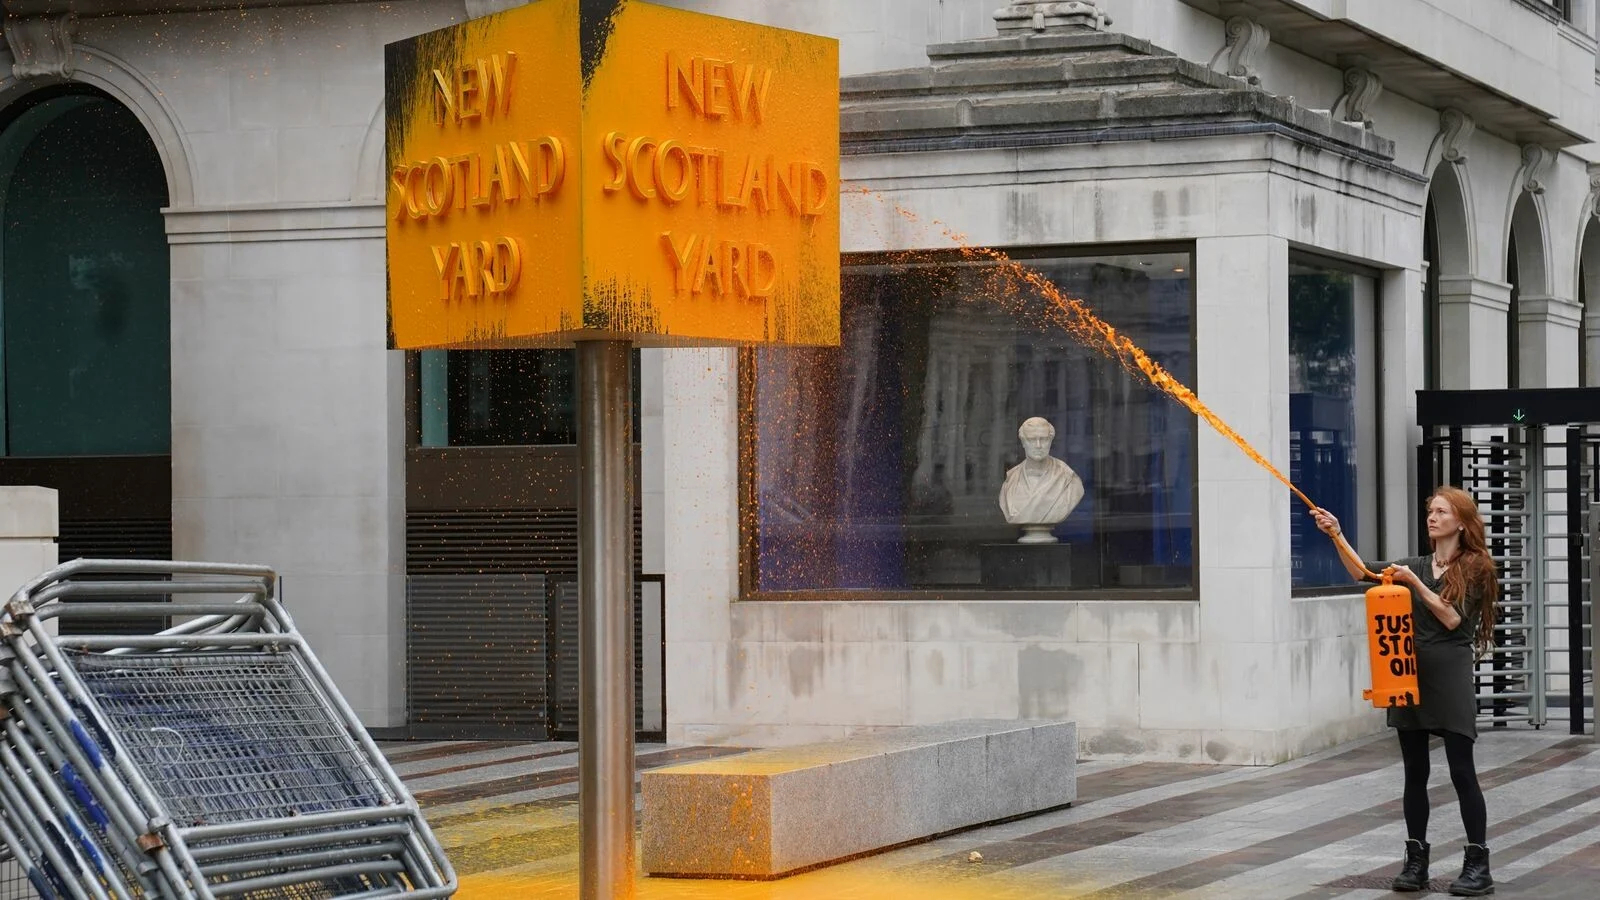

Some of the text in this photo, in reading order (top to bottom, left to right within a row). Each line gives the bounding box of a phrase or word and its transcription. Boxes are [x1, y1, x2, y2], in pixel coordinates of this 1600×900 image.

[433, 51, 517, 126] NEW
[666, 52, 772, 123] NEW
[392, 135, 565, 219] SCOTLAND
[604, 131, 828, 216] SCOTLAND
[431, 237, 521, 299] YARD
[661, 231, 776, 299] YARD
